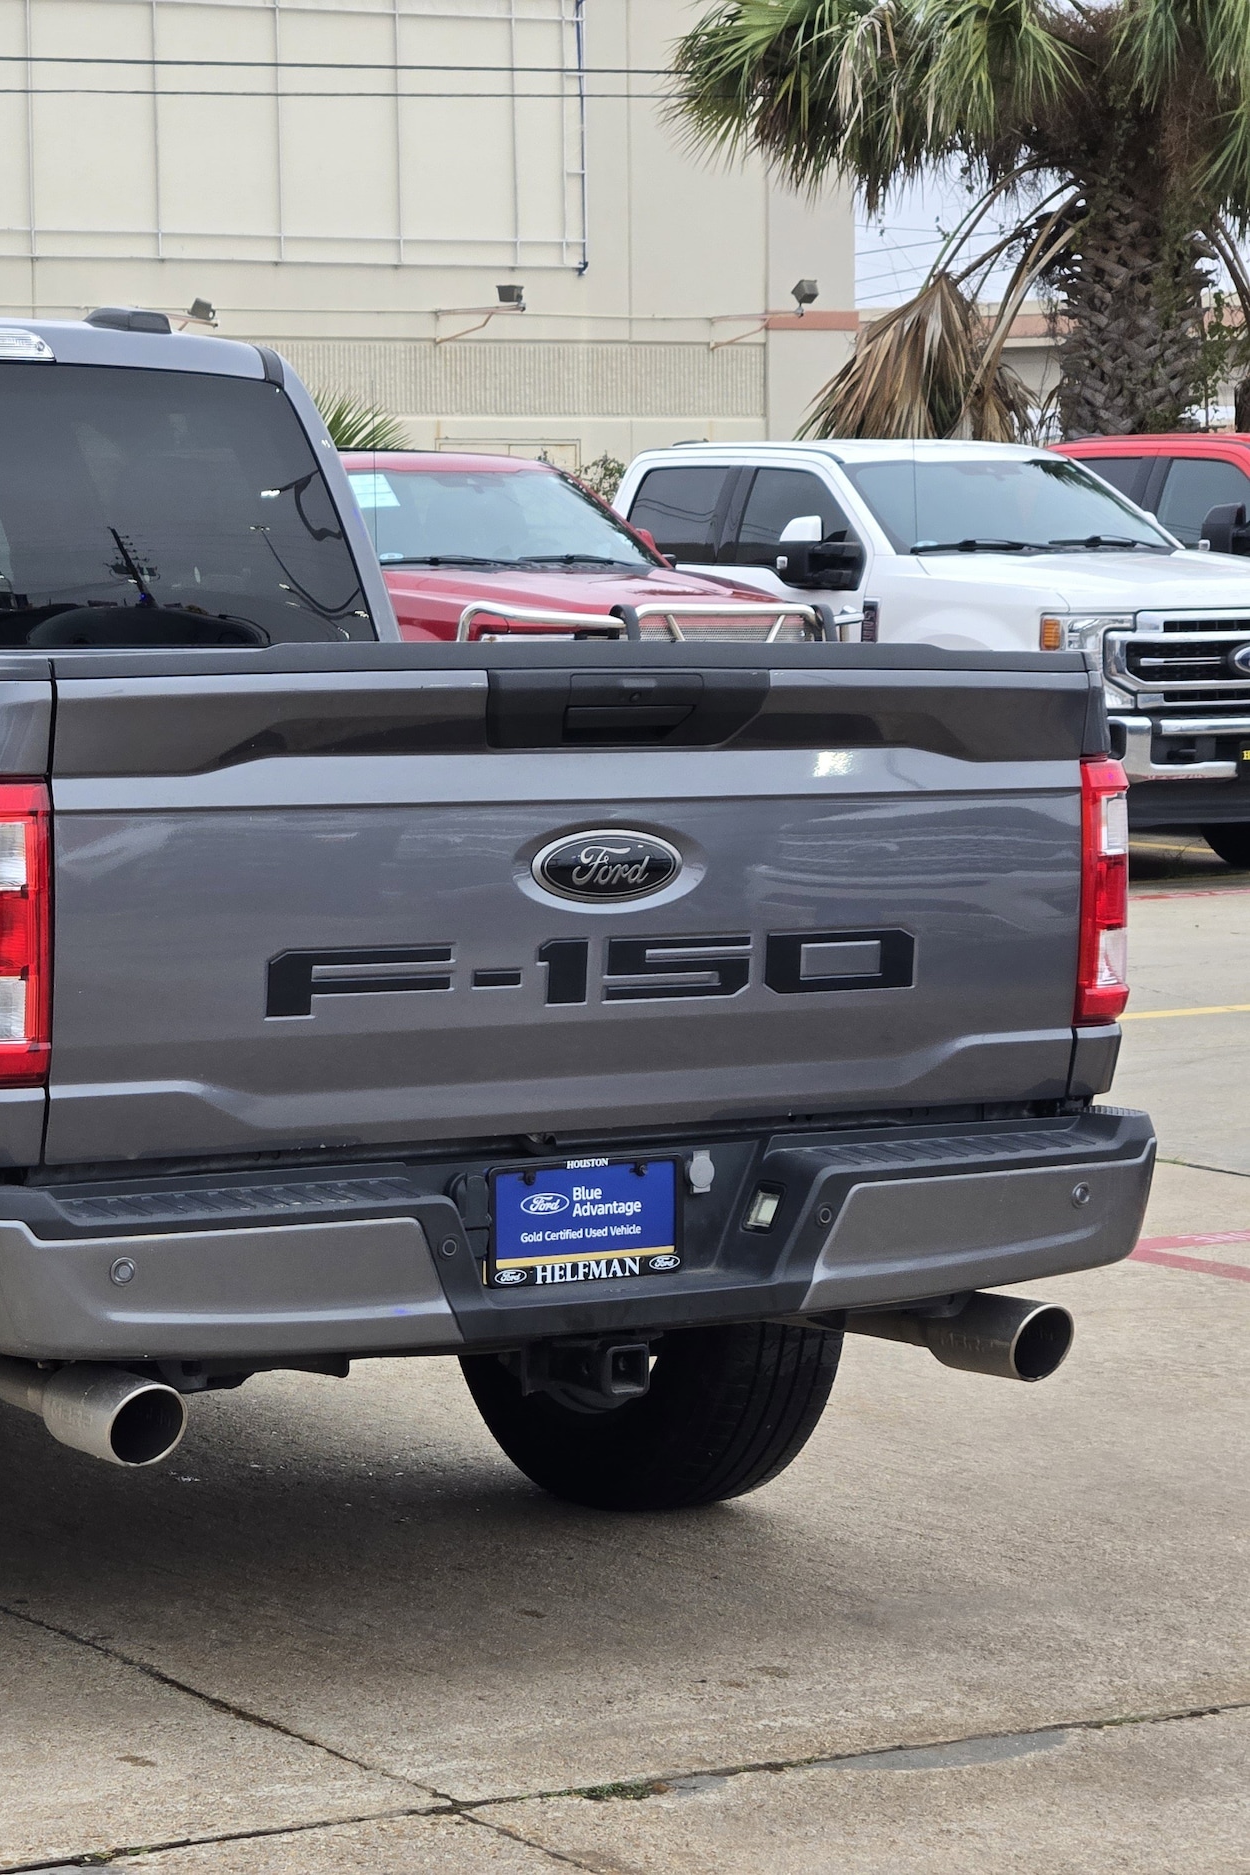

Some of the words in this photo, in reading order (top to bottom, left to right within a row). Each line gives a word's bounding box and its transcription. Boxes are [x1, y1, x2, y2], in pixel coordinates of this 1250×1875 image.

[570, 845, 649, 887] Ford
[265, 926, 917, 1021] F-150
[566, 1158, 609, 1169] HOUSTON
[572, 1186, 602, 1201] Blue
[530, 1196, 560, 1212] Ford
[572, 1200, 642, 1217] Advantage
[520, 1231, 543, 1243] Gold
[544, 1228, 583, 1241] Certified
[585, 1226, 608, 1238] Used
[609, 1224, 642, 1236] Vehicle
[534, 1256, 641, 1285] HELFMAN
